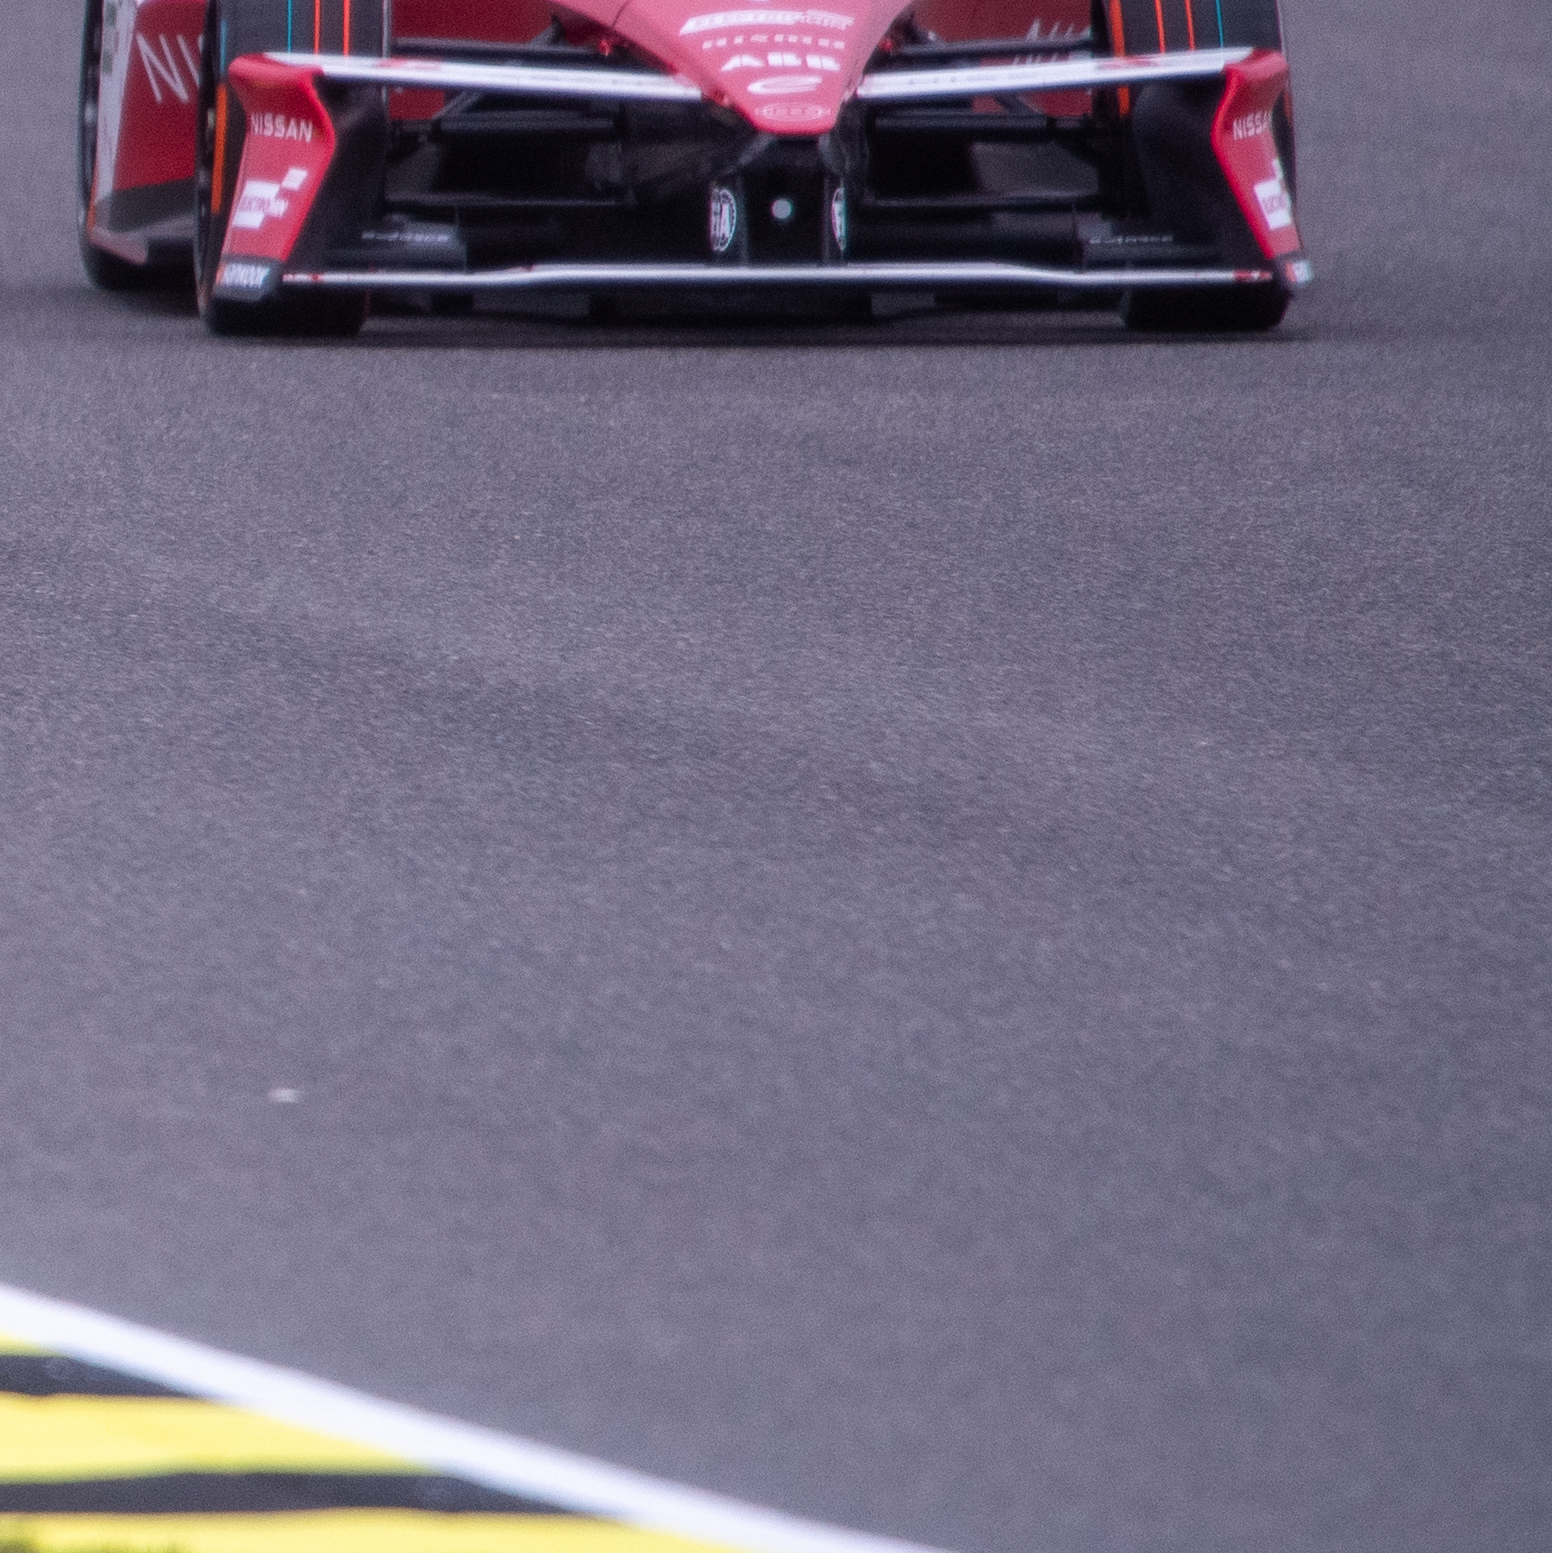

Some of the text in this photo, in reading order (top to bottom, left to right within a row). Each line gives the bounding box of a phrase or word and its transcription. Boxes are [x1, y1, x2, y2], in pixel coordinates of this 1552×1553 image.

[720, 52, 841, 72] ABB
[251, 112, 313, 144] NISSAN
[1232, 109, 1273, 141] NISSA
